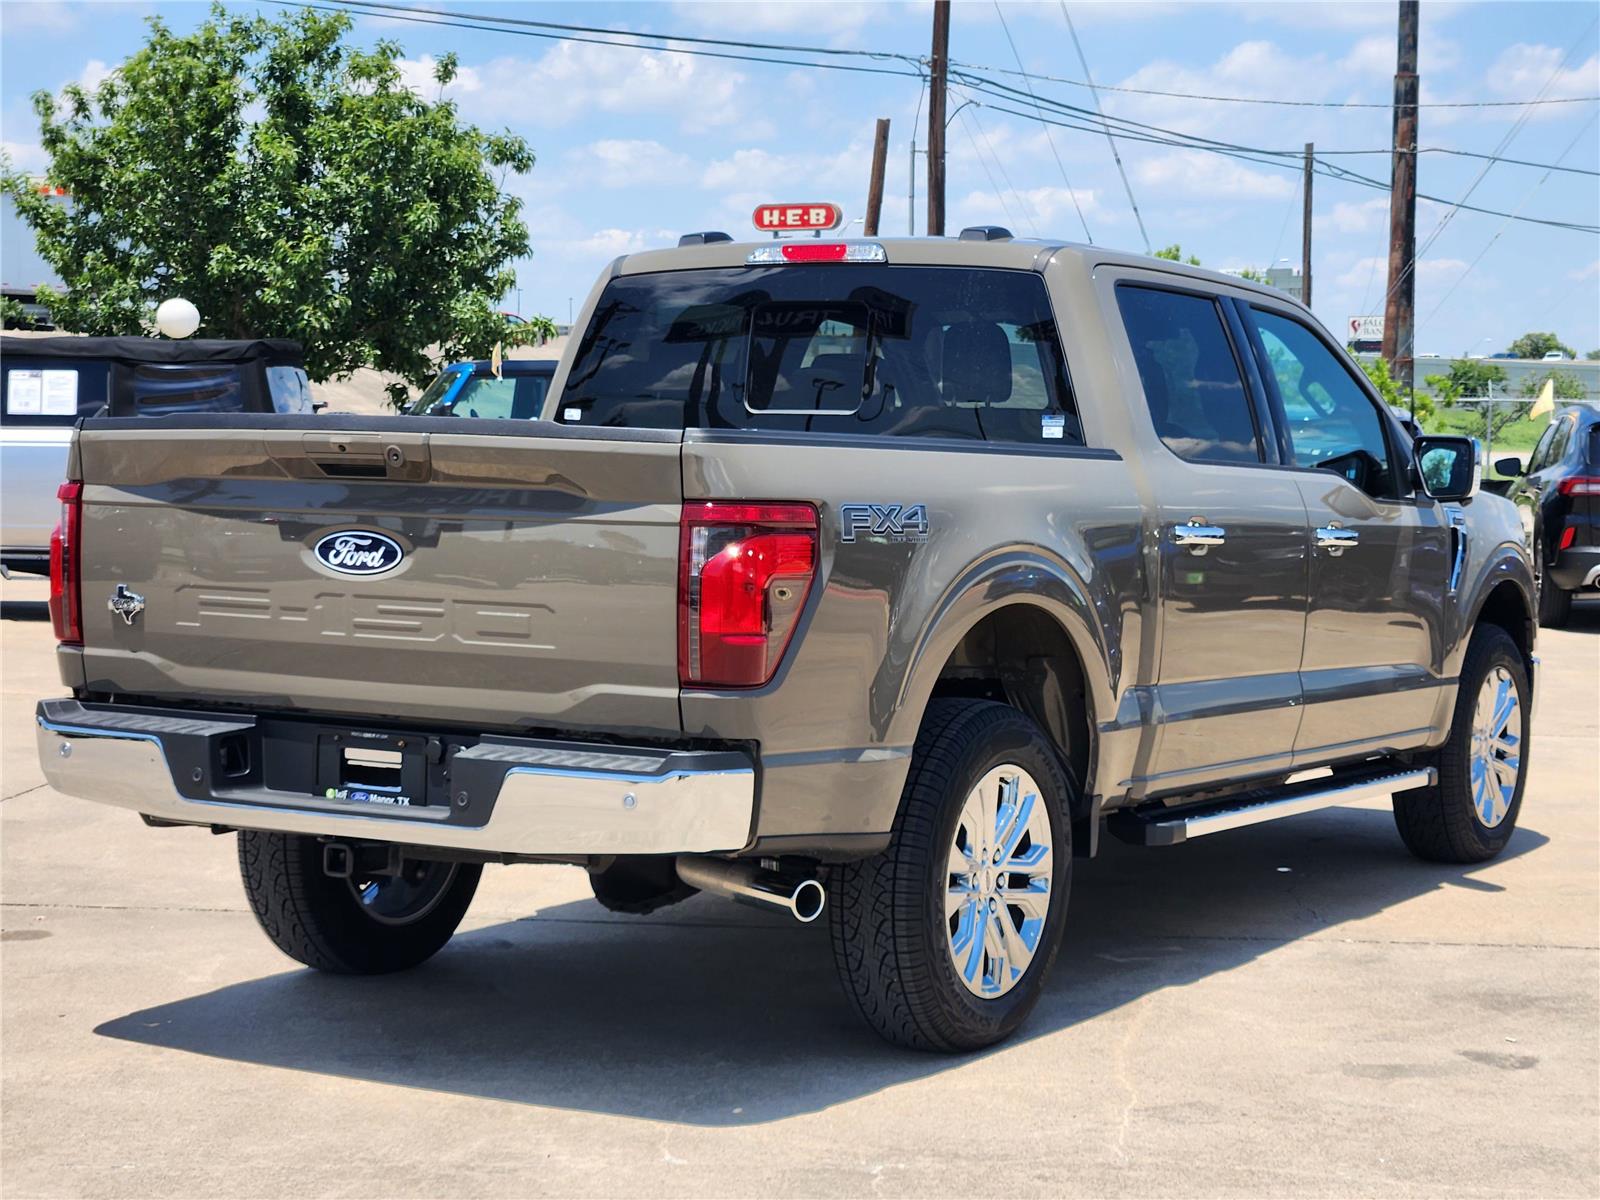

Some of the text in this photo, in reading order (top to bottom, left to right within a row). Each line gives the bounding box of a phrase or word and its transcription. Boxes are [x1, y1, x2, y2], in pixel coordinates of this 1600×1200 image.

[841, 504, 929, 543] FX4
[328, 536, 386, 568] Ford
[397, 796, 410, 806] TX
